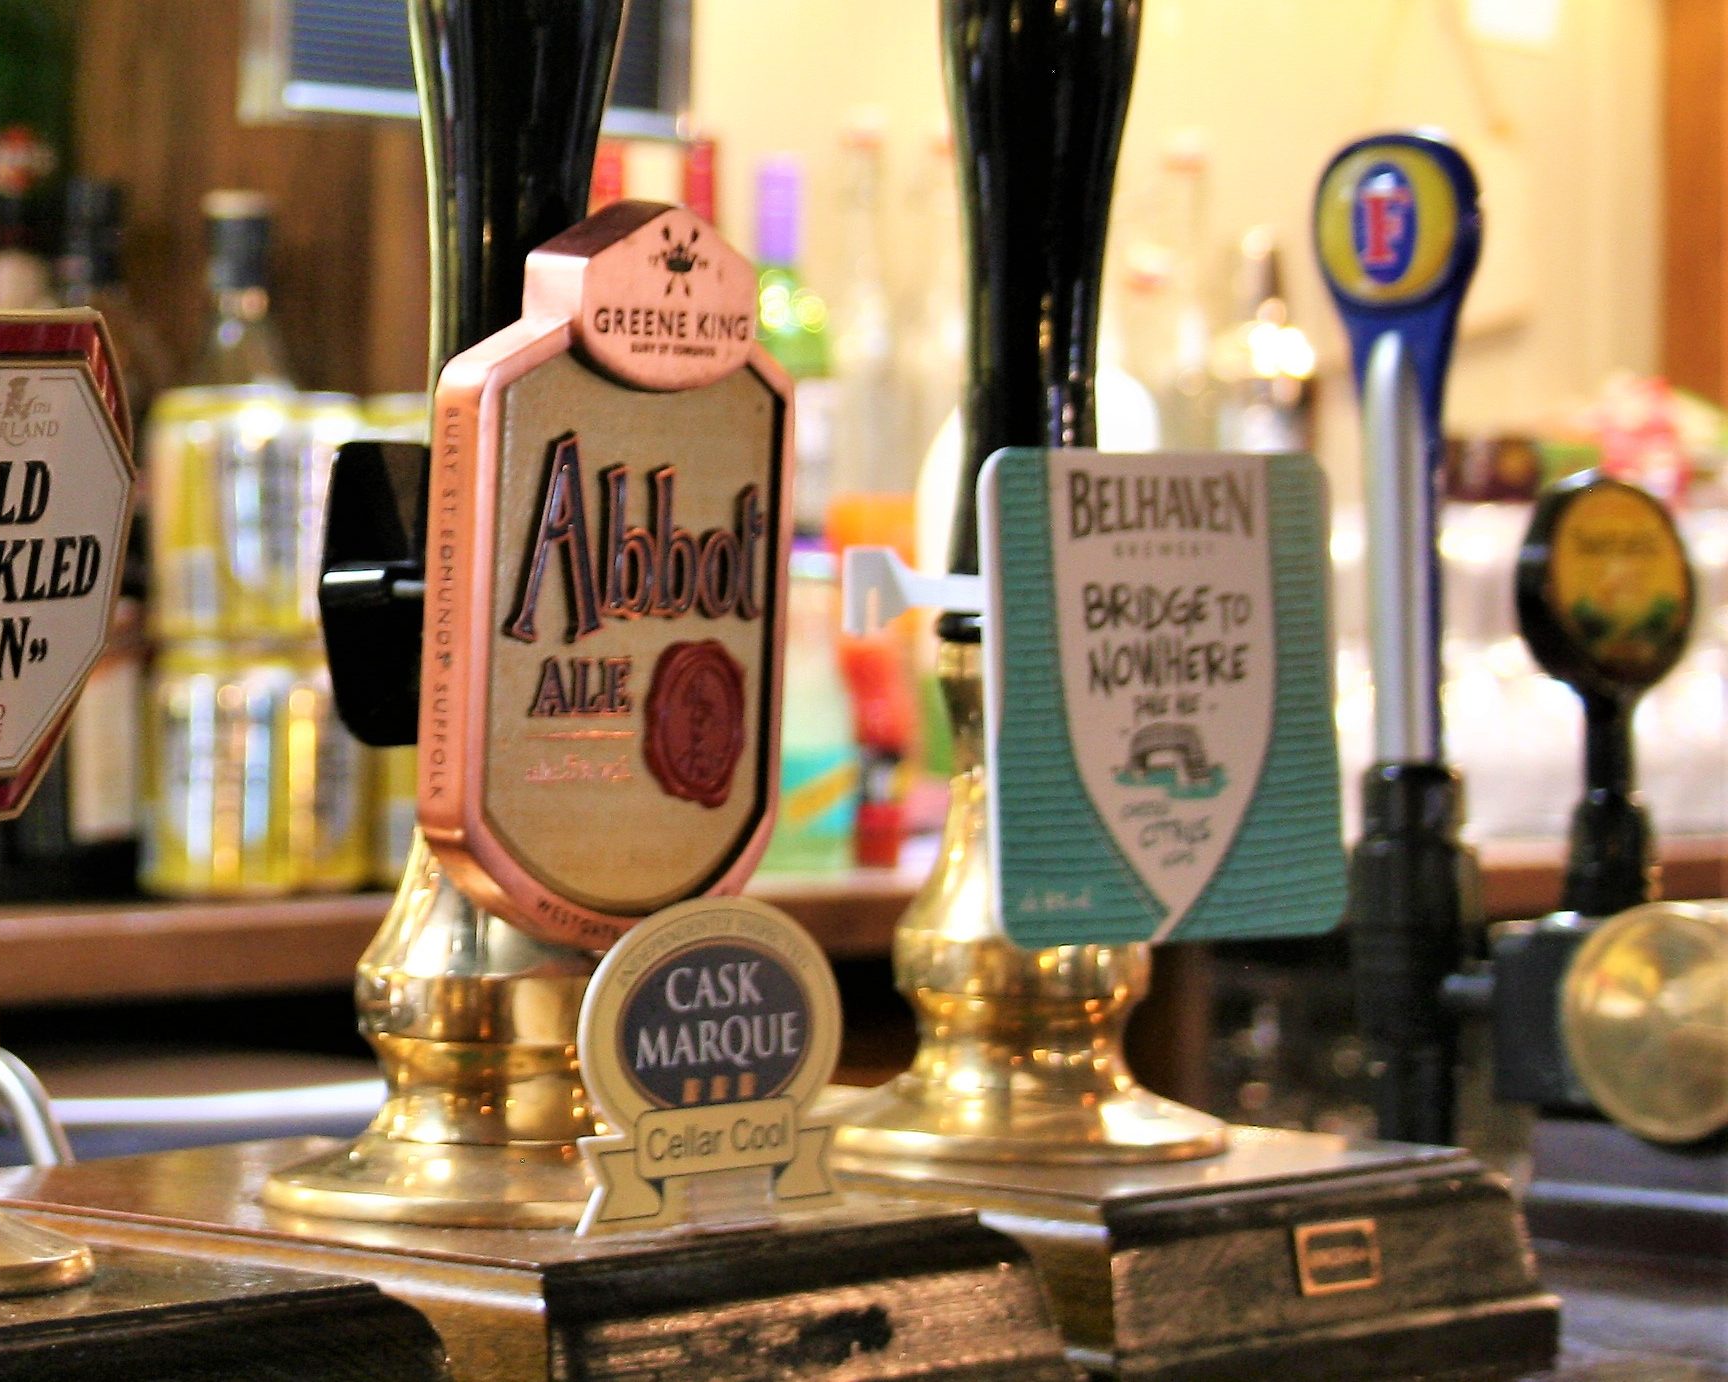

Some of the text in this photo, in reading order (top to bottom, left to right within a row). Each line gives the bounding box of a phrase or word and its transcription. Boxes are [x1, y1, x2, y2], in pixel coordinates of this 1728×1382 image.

[595, 307, 750, 341] GREENE KING
[1069, 468, 1254, 539] BELHAVEN
[503, 430, 766, 643] Abbot
[1082, 582, 1251, 636] BRIDGE TO
[530, 656, 633, 717] ALE
[1088, 638, 1251, 695] NOWHERE
[664, 960, 764, 1013] CASK
[635, 1011, 801, 1072] MARQUE
[647, 1113, 790, 1162] Cellar Cool
